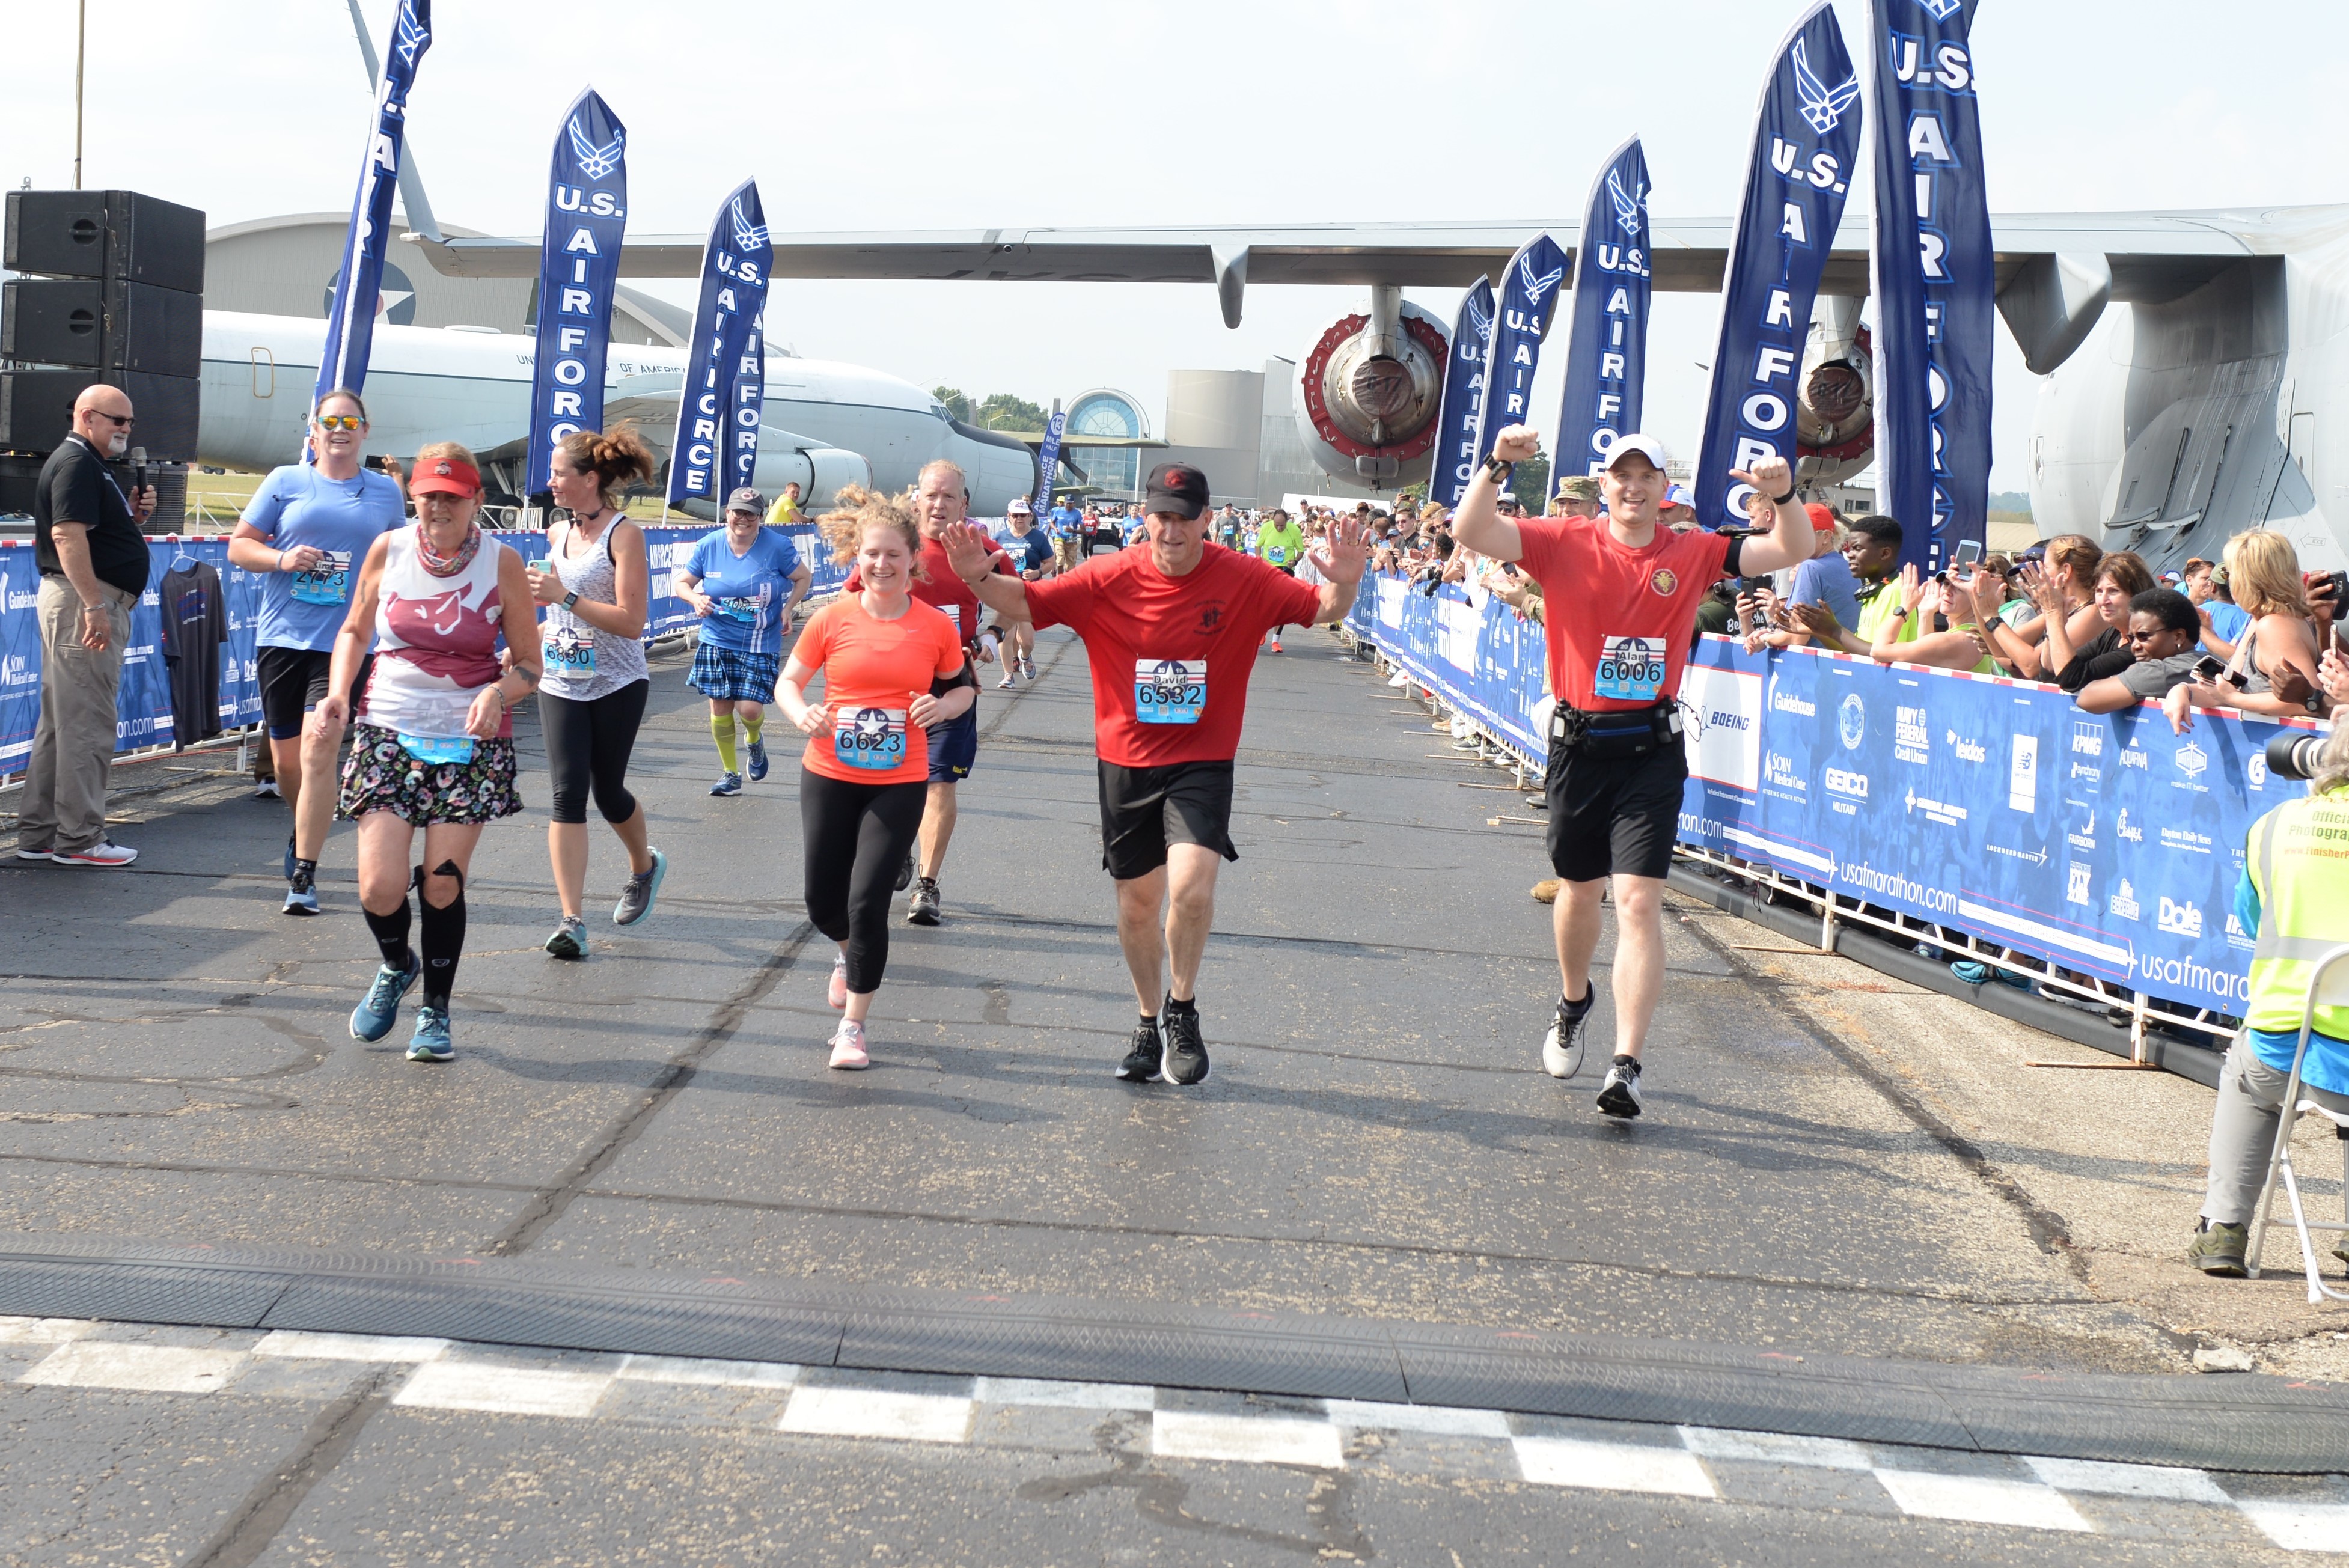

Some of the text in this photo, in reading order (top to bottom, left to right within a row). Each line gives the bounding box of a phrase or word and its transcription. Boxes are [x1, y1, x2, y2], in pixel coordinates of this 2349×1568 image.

[1892, 37, 1976, 90] U.S.
[1771, 138, 1845, 194] U.S.
[556, 186, 623, 217] U.S.
[1909, 117, 1949, 276] AIR
[718, 252, 762, 285] U.S.
[1599, 246, 1650, 276] U.S.
[1766, 203, 1805, 328] AR
[561, 229, 598, 316] AIR
[1507, 310, 1540, 335] U.S
[741, 313, 762, 374] AIR
[1602, 289, 1630, 379] AIR
[620, 363, 633, 373] OF
[640, 365, 685, 374] AMERIC
[1507, 344, 1532, 414] AIR
[551, 329, 587, 445] FORC
[1463, 374, 1483, 432] AIR
[1052, 418, 1063, 431] 13
[1727, 347, 1793, 522] FORC
[738, 386, 759, 487] FORC
[1046, 435, 1060, 446] MILE
[1453, 442, 1474, 501] FOR
[1039, 457, 1055, 514] MARATHON
[296, 569, 344, 587] 2773
[8, 590, 38, 609] Guidehou
[723, 599, 754, 614] 4084
[10, 654, 25, 672] SOIN
[547, 645, 590, 665] 6830
[1619, 652, 1645, 661] Alan
[1154, 675, 1187, 684] David
[1601, 661, 1661, 682] 6006
[1139, 685, 1201, 704] 6532
[1774, 692, 1815, 717] Guidehouse
[1711, 711, 1750, 730] BOEING
[1896, 706, 1918, 725] NAVY
[840, 731, 900, 752] 6623
[1895, 722, 1928, 744] FEDERAL
[1895, 745, 1928, 765] Credit Union
[1956, 736, 1985, 763] leidos
[2072, 734, 2102, 756] KPMG
[1772, 753, 1792, 773] SOIN
[2119, 748, 2148, 771] AQUAFINA
[1774, 772, 1793, 787] Medical
[1825, 768, 1868, 797] GEICO
[2077, 765, 2101, 780] synchrony
[2193, 784, 2209, 793] better
[1833, 801, 1857, 816] MILITARY
[2068, 833, 2095, 849] FAIRBORN
[2161, 827, 2211, 845] Dayton Daily News
[1987, 844, 2038, 862] LOCKHEED MARTIN
[2231, 849, 2245, 858] THE
[1840, 862, 1957, 916] usafmarathon.com
[2158, 896, 2202, 932] Dole
